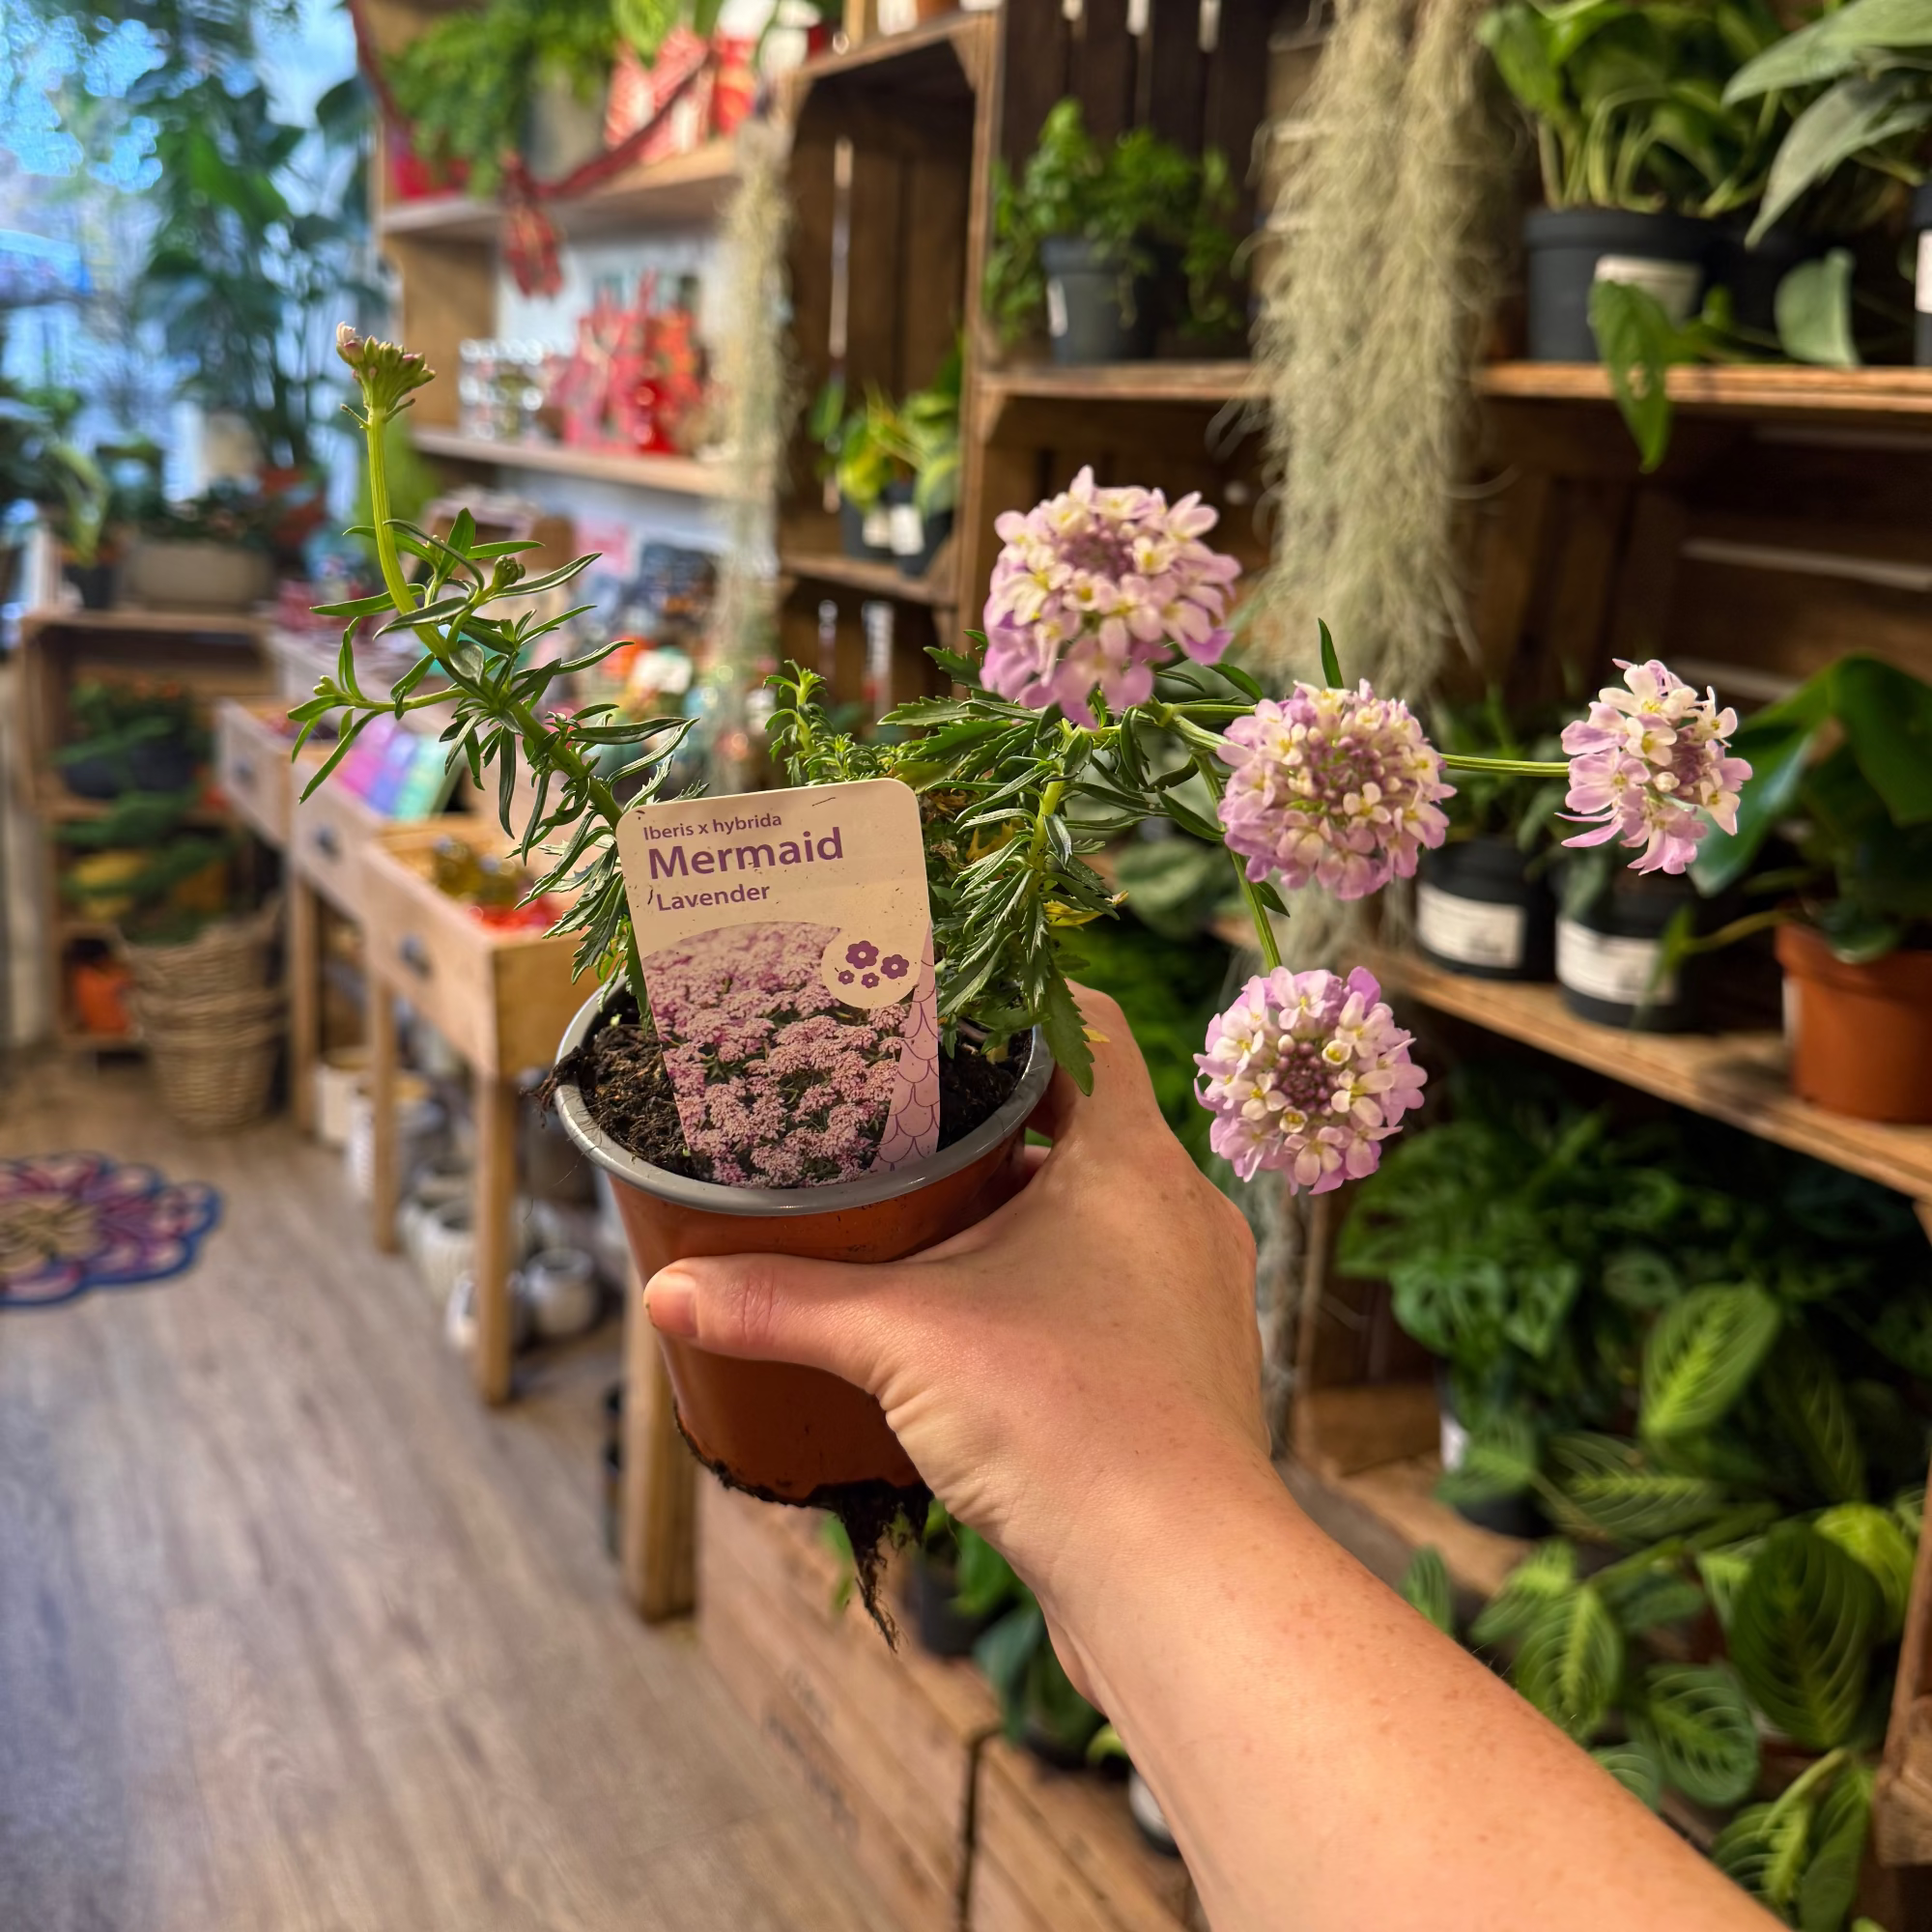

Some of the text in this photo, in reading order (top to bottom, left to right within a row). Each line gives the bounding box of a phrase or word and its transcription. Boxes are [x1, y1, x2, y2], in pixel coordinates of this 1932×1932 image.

[643, 813, 781, 840] Iberis x hybrida
[648, 827, 843, 879] Mermaid
[657, 884, 770, 911] Lavender
